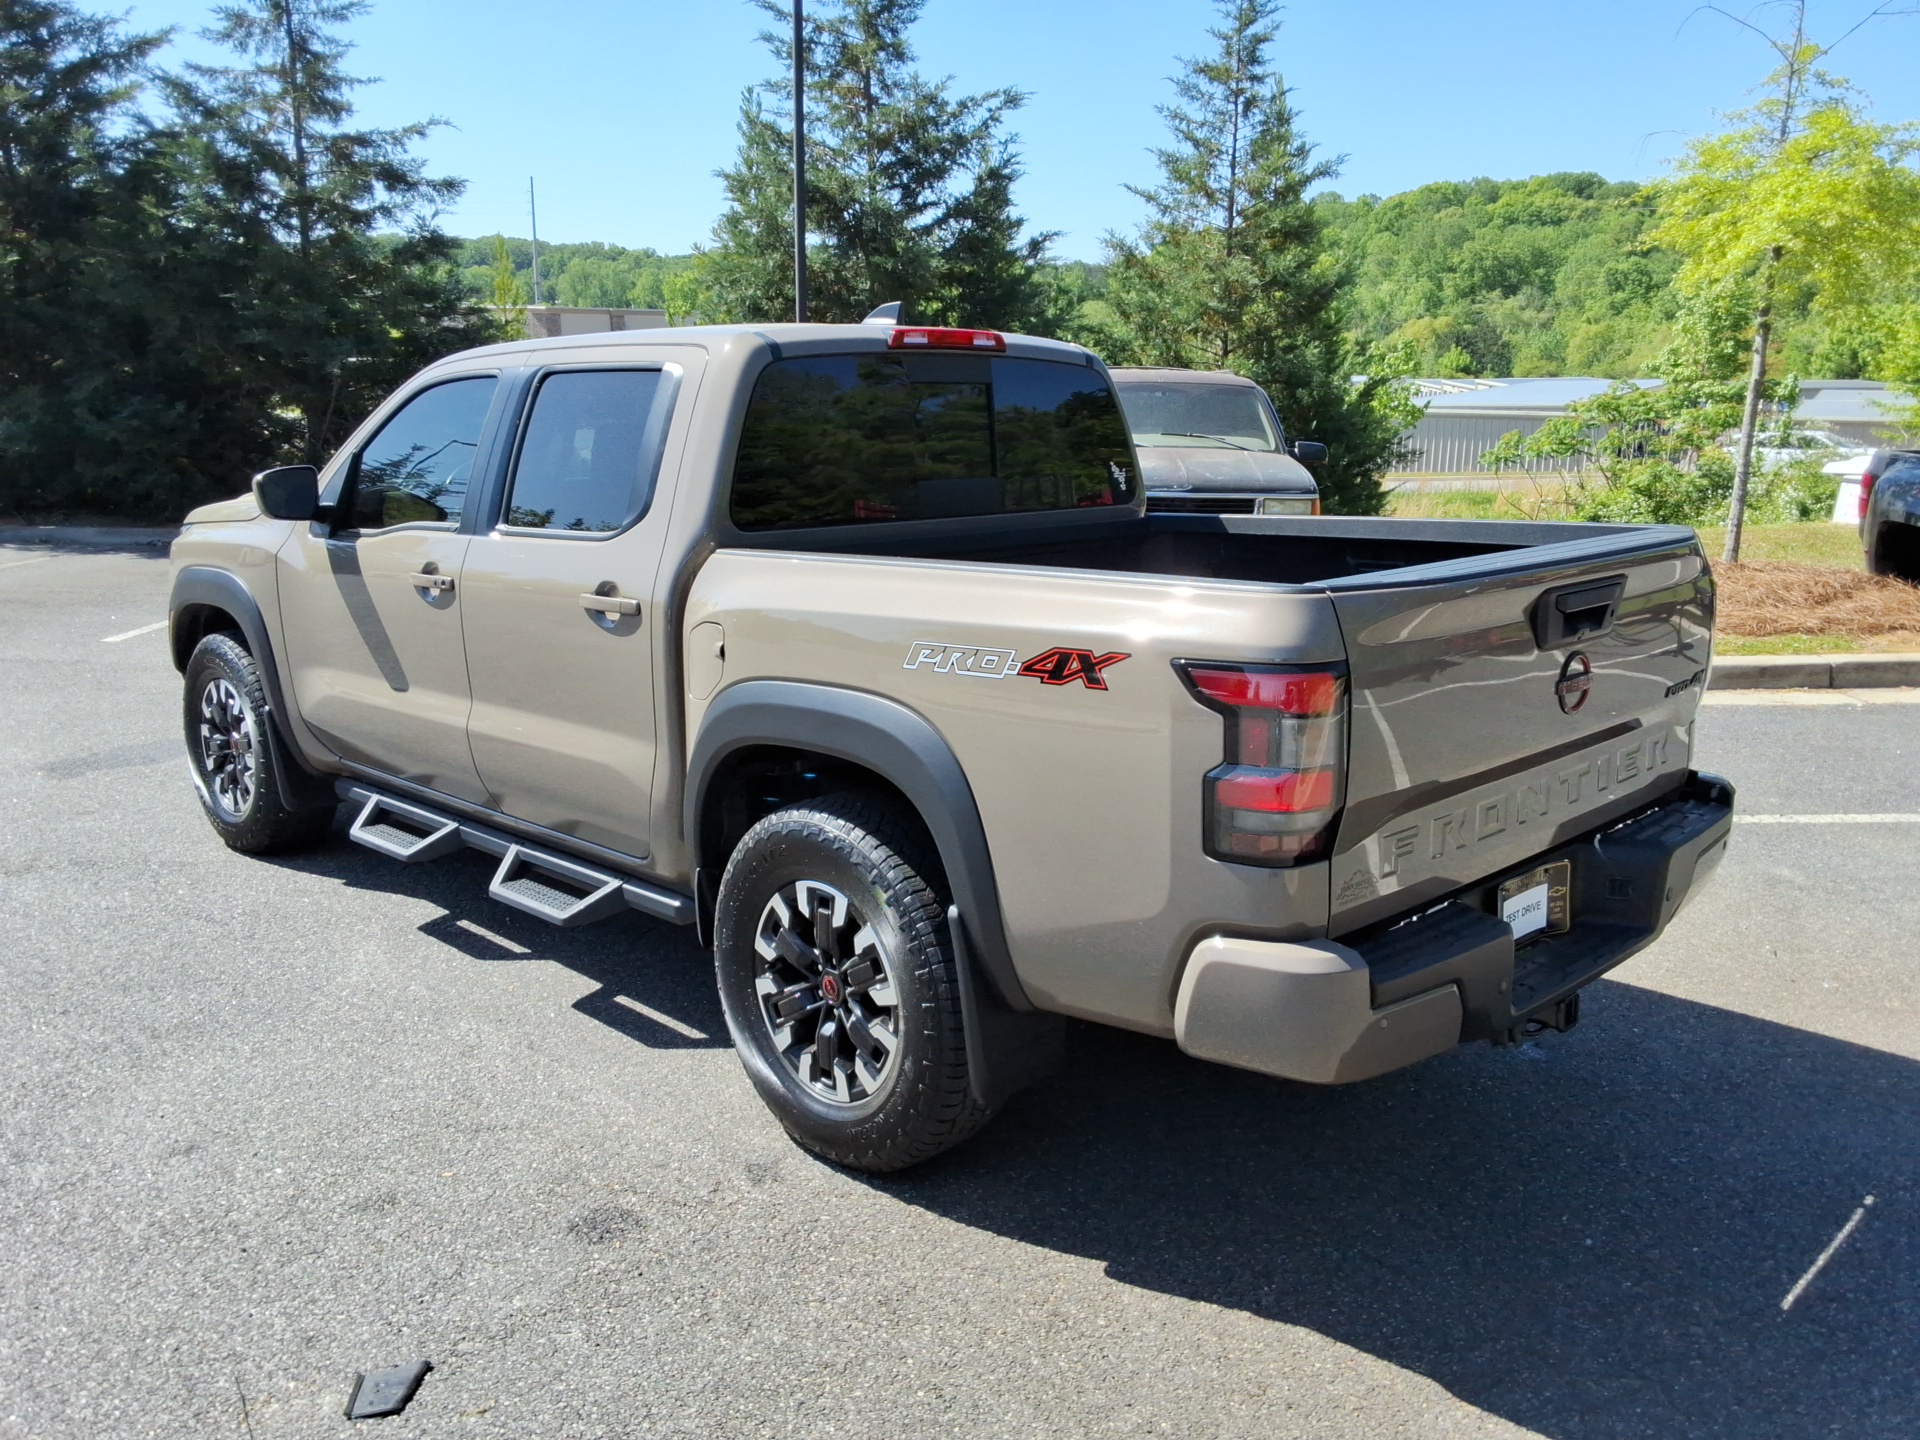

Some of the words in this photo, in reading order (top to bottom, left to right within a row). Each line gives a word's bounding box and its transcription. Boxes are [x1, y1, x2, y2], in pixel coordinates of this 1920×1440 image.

[902, 641, 1132, 691] PRO-4X
[1378, 731, 1669, 880] FRONTIER
[1506, 909, 1521, 923] TEST
[1521, 901, 1541, 917] DRIVE
